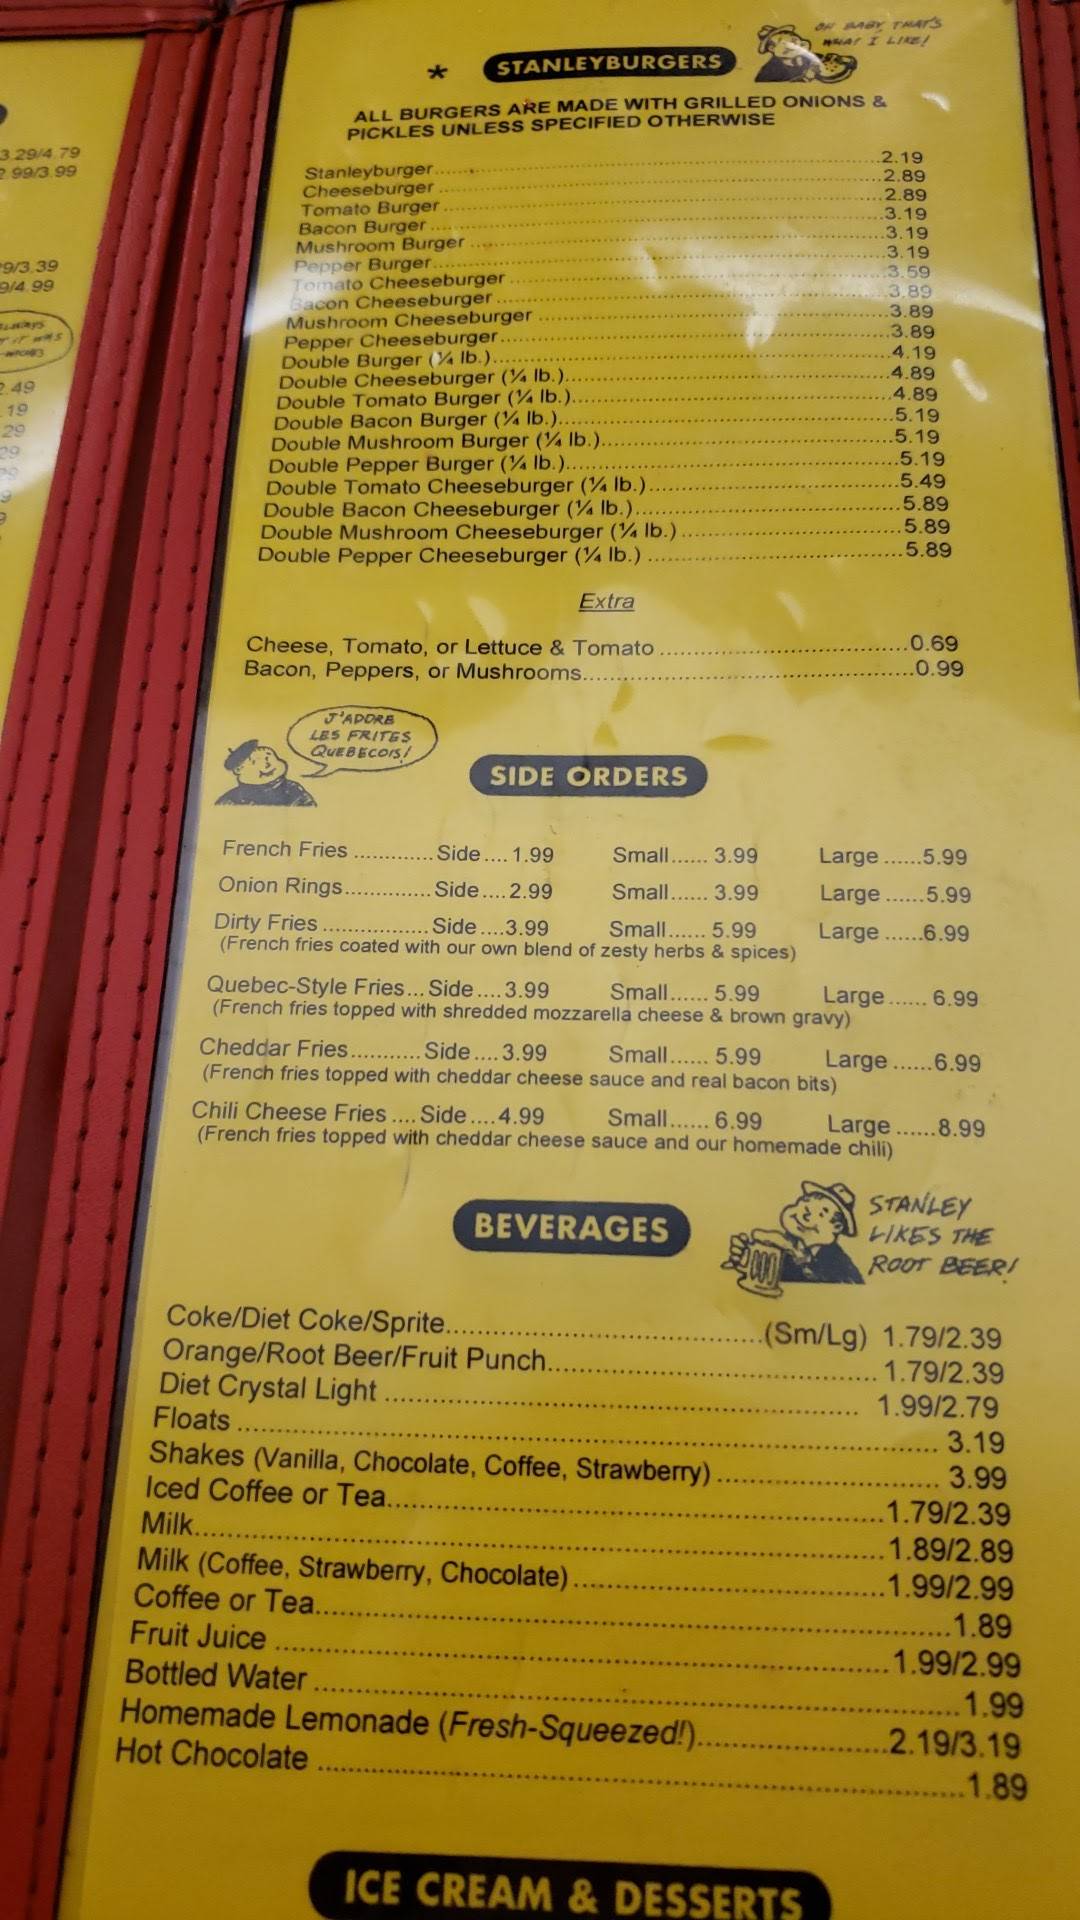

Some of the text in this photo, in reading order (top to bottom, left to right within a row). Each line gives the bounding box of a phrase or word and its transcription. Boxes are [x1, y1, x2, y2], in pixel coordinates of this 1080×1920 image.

[886, 34, 930, 47] LIKE!
[495, 51, 723, 78] STANLEYBURGERS
[354, 95, 888, 123] ALL BURGERS ARE MADE WITH GRILLED ONIONS &
[347, 112, 776, 141] PICKLES UNLESS SPECIFIED OTHERWISE
[304, 150, 923, 181] Stanleyburger 2.19
[302, 168, 926, 199] Cheeseburger 2.89
[301, 187, 927, 217] Tomato Burger 2.89
[298, 206, 927, 236] Bacon Burger 3.19
[296, 225, 929, 254] Mushroom Burger 3.19
[0, 260, 59, 275] 9/3.39
[279, 374, 348, 390] Double
[354, 370, 495, 389] Cheeseburger
[533, 367, 565, 386] lb.)
[891, 365, 935, 381] 4.89
[261, 524, 333, 541] Double
[339, 524, 448, 541] Mushroom
[455, 523, 604, 544] Cheeseburger
[645, 522, 677, 542] lb.)
[904, 517, 951, 535] 5.89
[578, 592, 636, 613] Extra
[246, 634, 959, 657] Cheese, Tomato, or Lettuce & Tomato 0.69
[244, 659, 964, 682] Bacon, Peppers, or Mushrooms 0.99
[323, 710, 395, 726] J'ADORE
[309, 729, 412, 744] LES FRITES
[309, 745, 413, 765] QUEBECOIS!
[490, 765, 688, 787] SIDE ORDERS
[223, 839, 968, 868] French Fries Side 1.99 Small 3.99 Large 5.99
[218, 875, 972, 906] Onion Rings Side 2.99 Small 3.99 Large 5.99
[220, 935, 796, 963] (French fries coated with our own blend of zesty herbs & spices)
[869, 1191, 973, 1221] STANLEY
[474, 1212, 669, 1243] BEVERAGES
[868, 1224, 995, 1247] LIKES THE
[867, 1254, 1020, 1284] ROOT BEER!
[166, 1303, 1002, 1353] Coke/Diet Coke/Sprite (Sm/Lg) 1.79/2.39
[163, 1337, 1005, 1385] Orange/Root Beer/Fruit Punch 1.79/2.39
[159, 1371, 999, 1420] Diet Crystal Light 1.99/2.79
[153, 1405, 1005, 1455] Floats 3.19
[149, 1439, 1007, 1490] Shakes (Vanilla, Chocolate, Coffee, Strawberry) 3.99
[146, 1475, 1011, 1527] Iced Coffee or Tea 1.79/2.39
[141, 1510, 1014, 1564] Milk 1.89/2.89
[137, 1546, 1014, 1601] Milk (Coffee, Strawberry, Chocolate) 1.99/2.99
[134, 1582, 1012, 1639] Coffee or Tea 1.89
[130, 1619, 1021, 1679] Fruit Juice 1.99/2.99
[125, 1658, 1024, 1719] Bottled Water 1.99
[120, 1697, 1021, 1760] Homemade Lemonade (Fresh-Squeezed!) 2.19/3.19
[115, 1736, 1028, 1802] Hot Chocolate 1.89
[345, 1869, 803, 1920] ICE CREAM & DESSERTS
